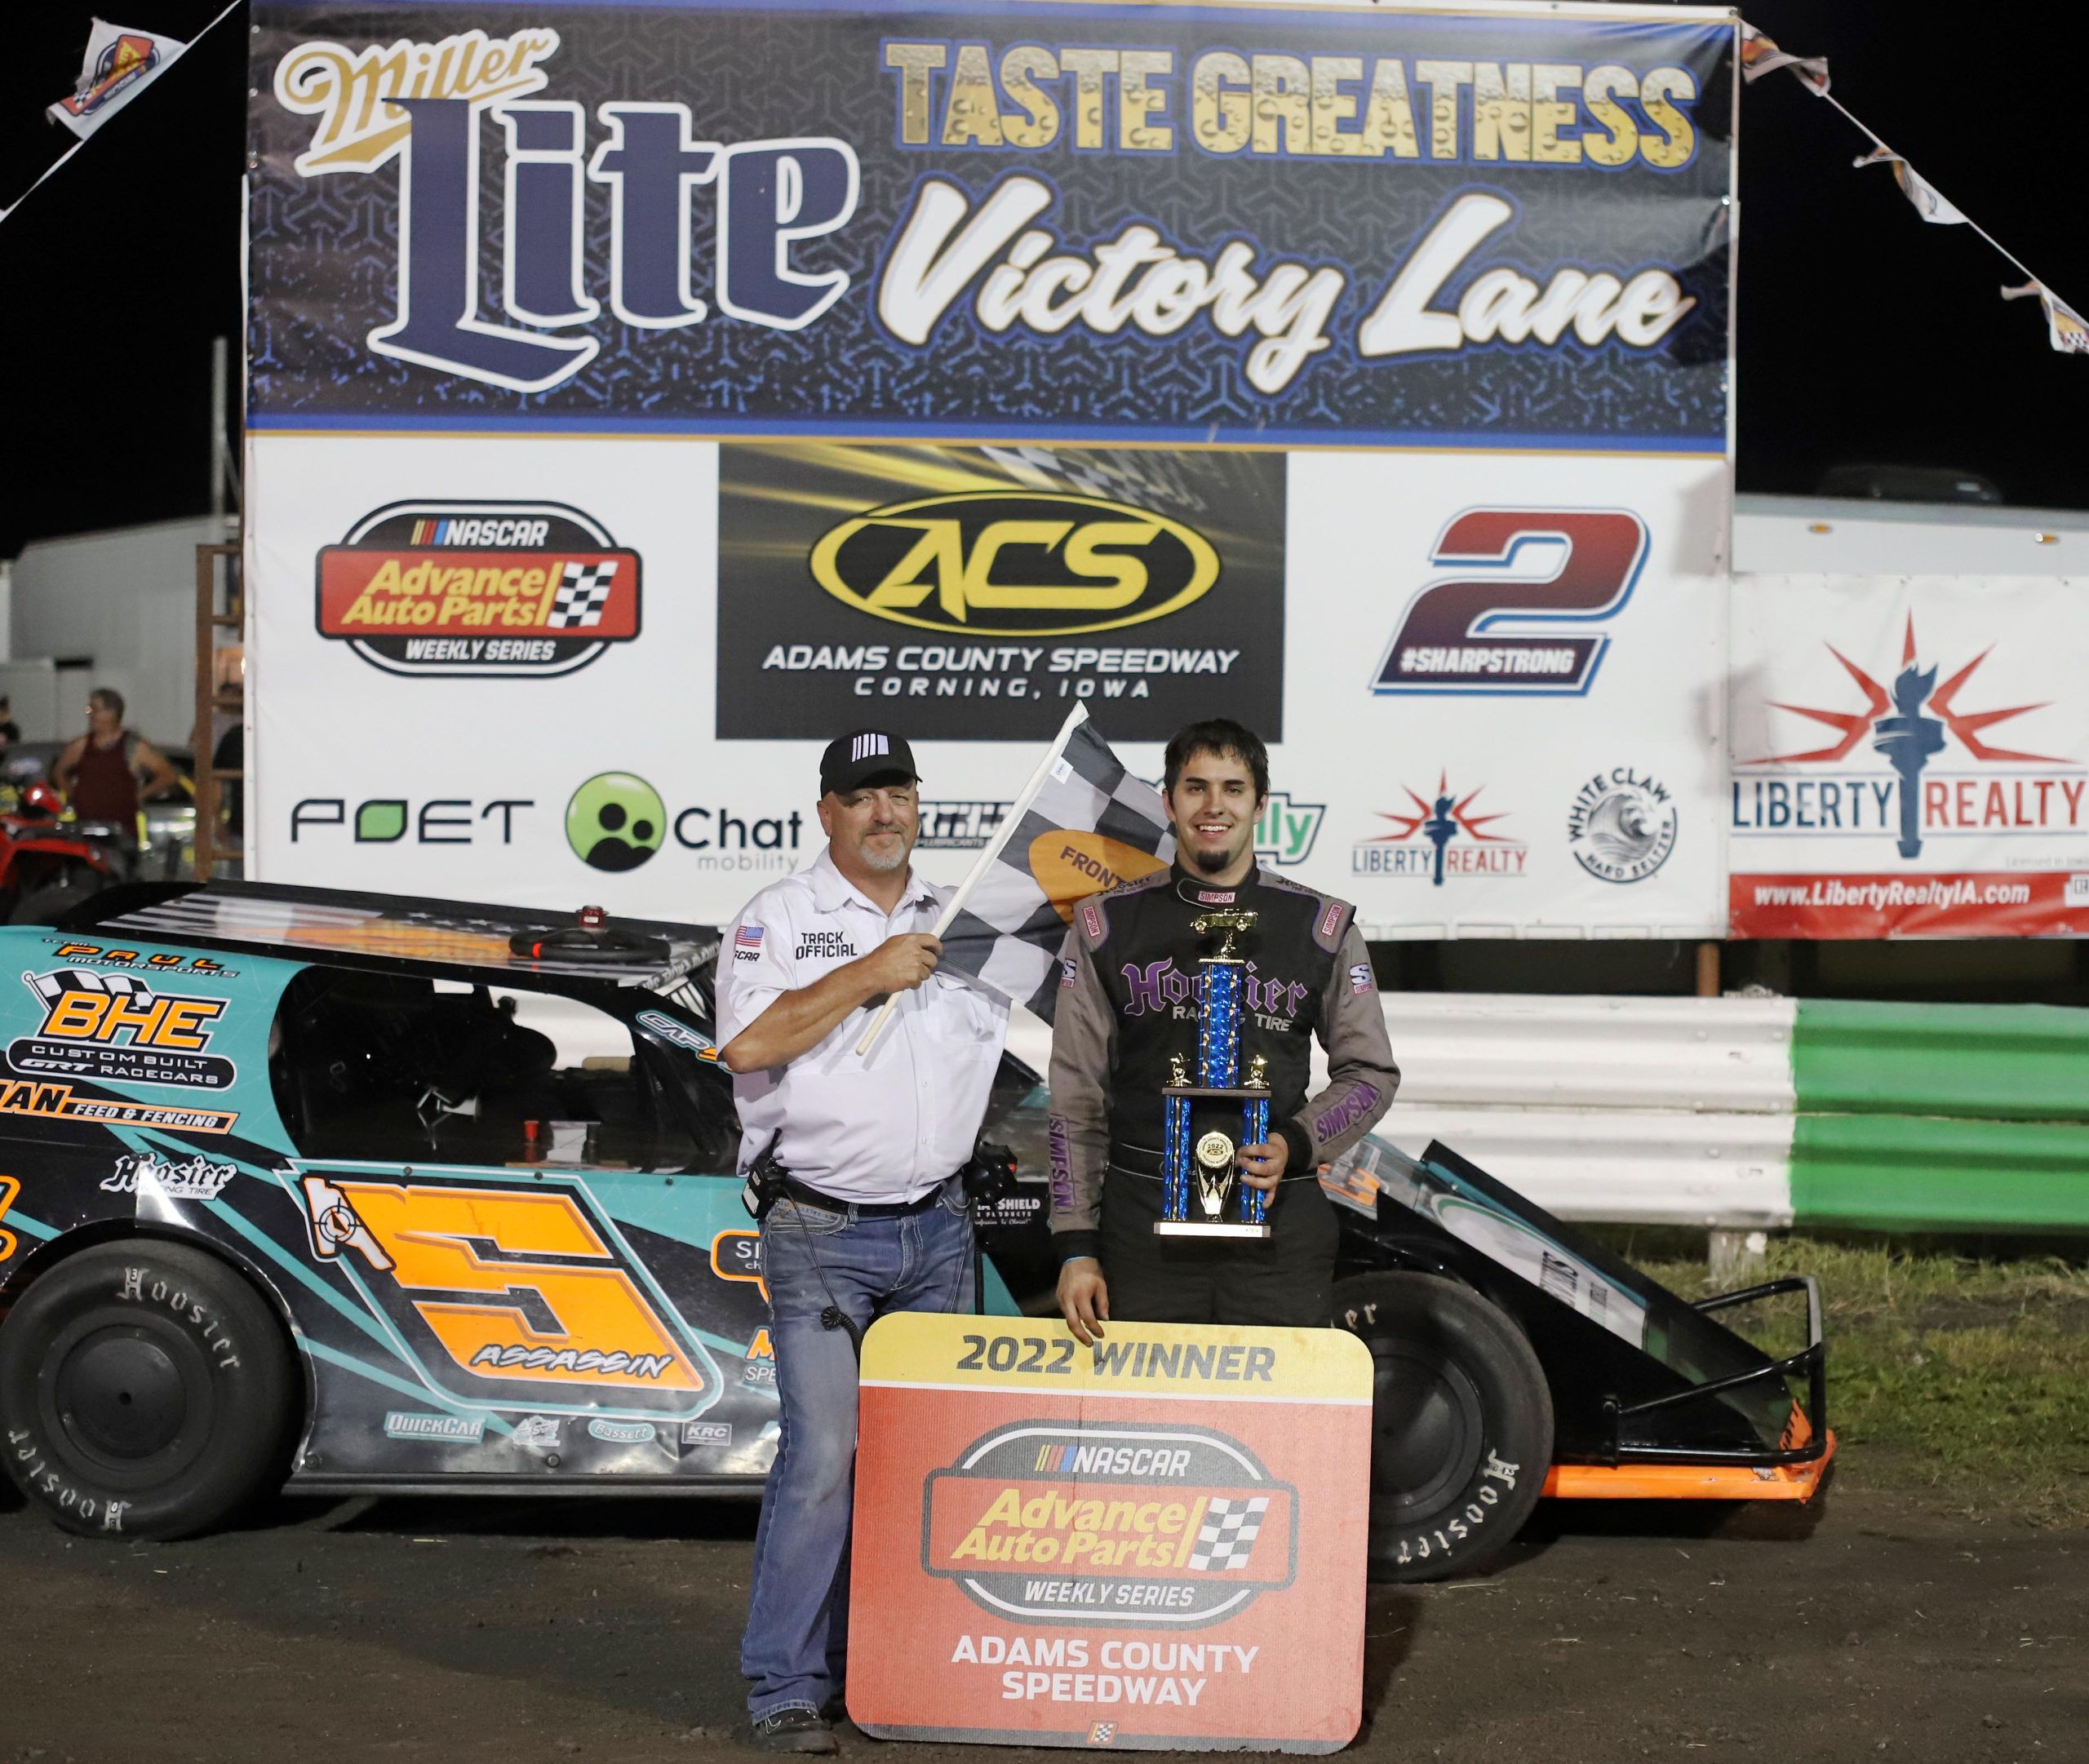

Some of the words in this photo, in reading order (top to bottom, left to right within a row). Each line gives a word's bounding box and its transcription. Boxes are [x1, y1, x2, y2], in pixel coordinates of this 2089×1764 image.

[278, 30, 558, 175] Miller
[886, 43, 1173, 150] TASTE
[1192, 51, 1696, 167] GREATNESS
[367, 96, 859, 392] Lite
[880, 177, 1344, 394] Victory
[1359, 193, 1696, 357] Lane
[444, 520, 549, 546] NASCAR
[364, 561, 546, 596] Advance
[867, 519, 1162, 623] ACS
[341, 595, 436, 625] Auto
[437, 596, 536, 626] Parts
[1371, 505, 1650, 695] 2
[406, 639, 481, 659] WEEKLY
[487, 640, 556, 660] SERIES
[762, 645, 889, 670] ADAMS
[896, 646, 1043, 671] COUNTY
[1048, 648, 1240, 674] SPEEDWAY
[1400, 646, 1575, 673] #SHARPSTRONG
[854, 677, 1041, 700] CORNING,
[1059, 680, 1150, 698] IOWA
[1568, 773, 1608, 843] WHITE
[1612, 767, 1670, 804] CLAW
[1732, 782, 1893, 828] LIBERTY
[1926, 781, 2087, 827] REALTY
[291, 799, 534, 844] POET
[674, 806, 804, 850] Chat
[698, 851, 800, 874] mobility
[1352, 849, 1432, 872] LIBERTY
[1447, 849, 1527, 872] REALTY
[1199, 892, 1235, 902] SIMPSON
[1754, 880, 2029, 911] www.LibertyRealtyIA.com
[1084, 907, 1100, 935] SIMPSON
[1323, 905, 1342, 934] SIMPSON
[796, 943, 858, 960] OFFICIAL
[801, 931, 844, 945] TRACK
[54, 943, 224, 969] PAUL
[68, 956, 239, 978] MOTORSPORTS
[1121, 956, 1308, 1017] Hoier
[43, 991, 221, 1049] BHE
[1254, 1013, 1293, 1032] TIRE
[20, 1057, 94, 1072] GRT
[100, 1066, 219, 1084] RACECARS
[31, 1044, 136, 1062] CUSTOM
[144, 1056, 207, 1070] BUILT
[0, 1081, 68, 1113] AN
[73, 1104, 121, 1119] FEED
[123, 1109, 137, 1121] &
[140, 1111, 219, 1128] FENCING
[100, 1153, 238, 1192] Hosier
[1049, 1118, 1071, 1208] SIMPSON
[188, 1187, 215, 1195] TIRE
[997, 1198, 1041, 1210] SHIELD
[116, 1266, 241, 1370] Hoosier
[469, 1344, 675, 1379] ASSASSIN
[956, 1335, 1076, 1374] 2022
[1092, 1341, 1275, 1382] WINNER
[594, 1424, 647, 1438] Bassett
[687, 1427, 728, 1439] KRC
[1071, 1447, 1191, 1478] NASCAR
[8, 1429, 132, 1531] Hoosier
[977, 1489, 1187, 1534] Advance
[1397, 1448, 1520, 1564] Hoosier
[951, 1527, 1060, 1562] Auto
[1061, 1531, 1175, 1568] Parts
[1024, 1580, 1116, 1605] WEEKLY
[1116, 1584, 1195, 1607] SERIES
[951, 1636, 1089, 1669] ADAMS
[1101, 1641, 1260, 1674] COUNTY
[1001, 1672, 1207, 1706] SPEEDWAY
